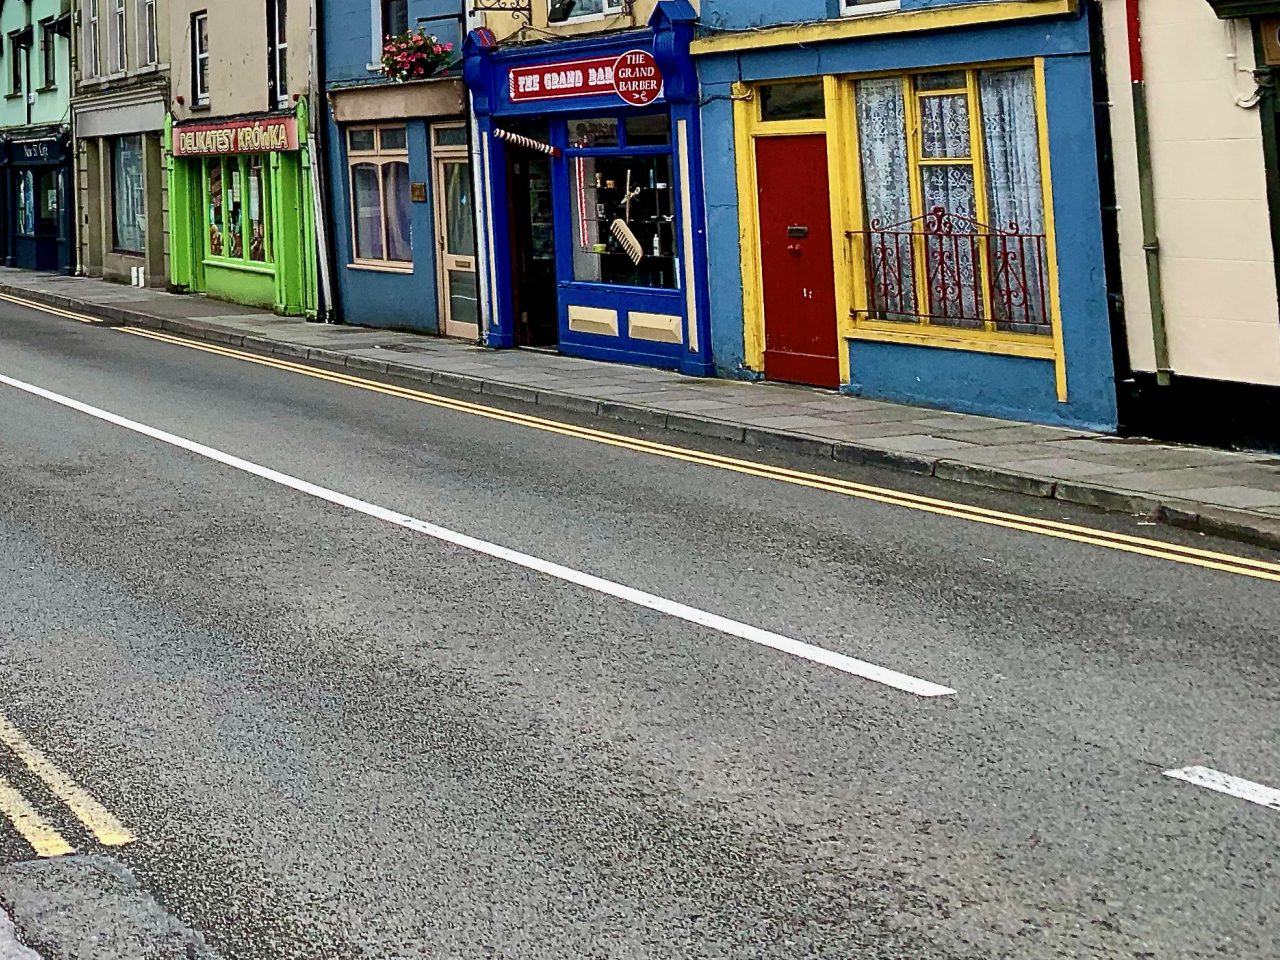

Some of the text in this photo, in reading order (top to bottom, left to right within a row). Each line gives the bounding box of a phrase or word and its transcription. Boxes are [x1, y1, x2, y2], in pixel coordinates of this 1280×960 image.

[626, 54, 645, 65] THE
[618, 67, 655, 78] GRAND
[518, 65, 613, 93] THE GRAND BAR
[619, 80, 658, 92] BARBER
[179, 128, 236, 154] DELIKATESY
